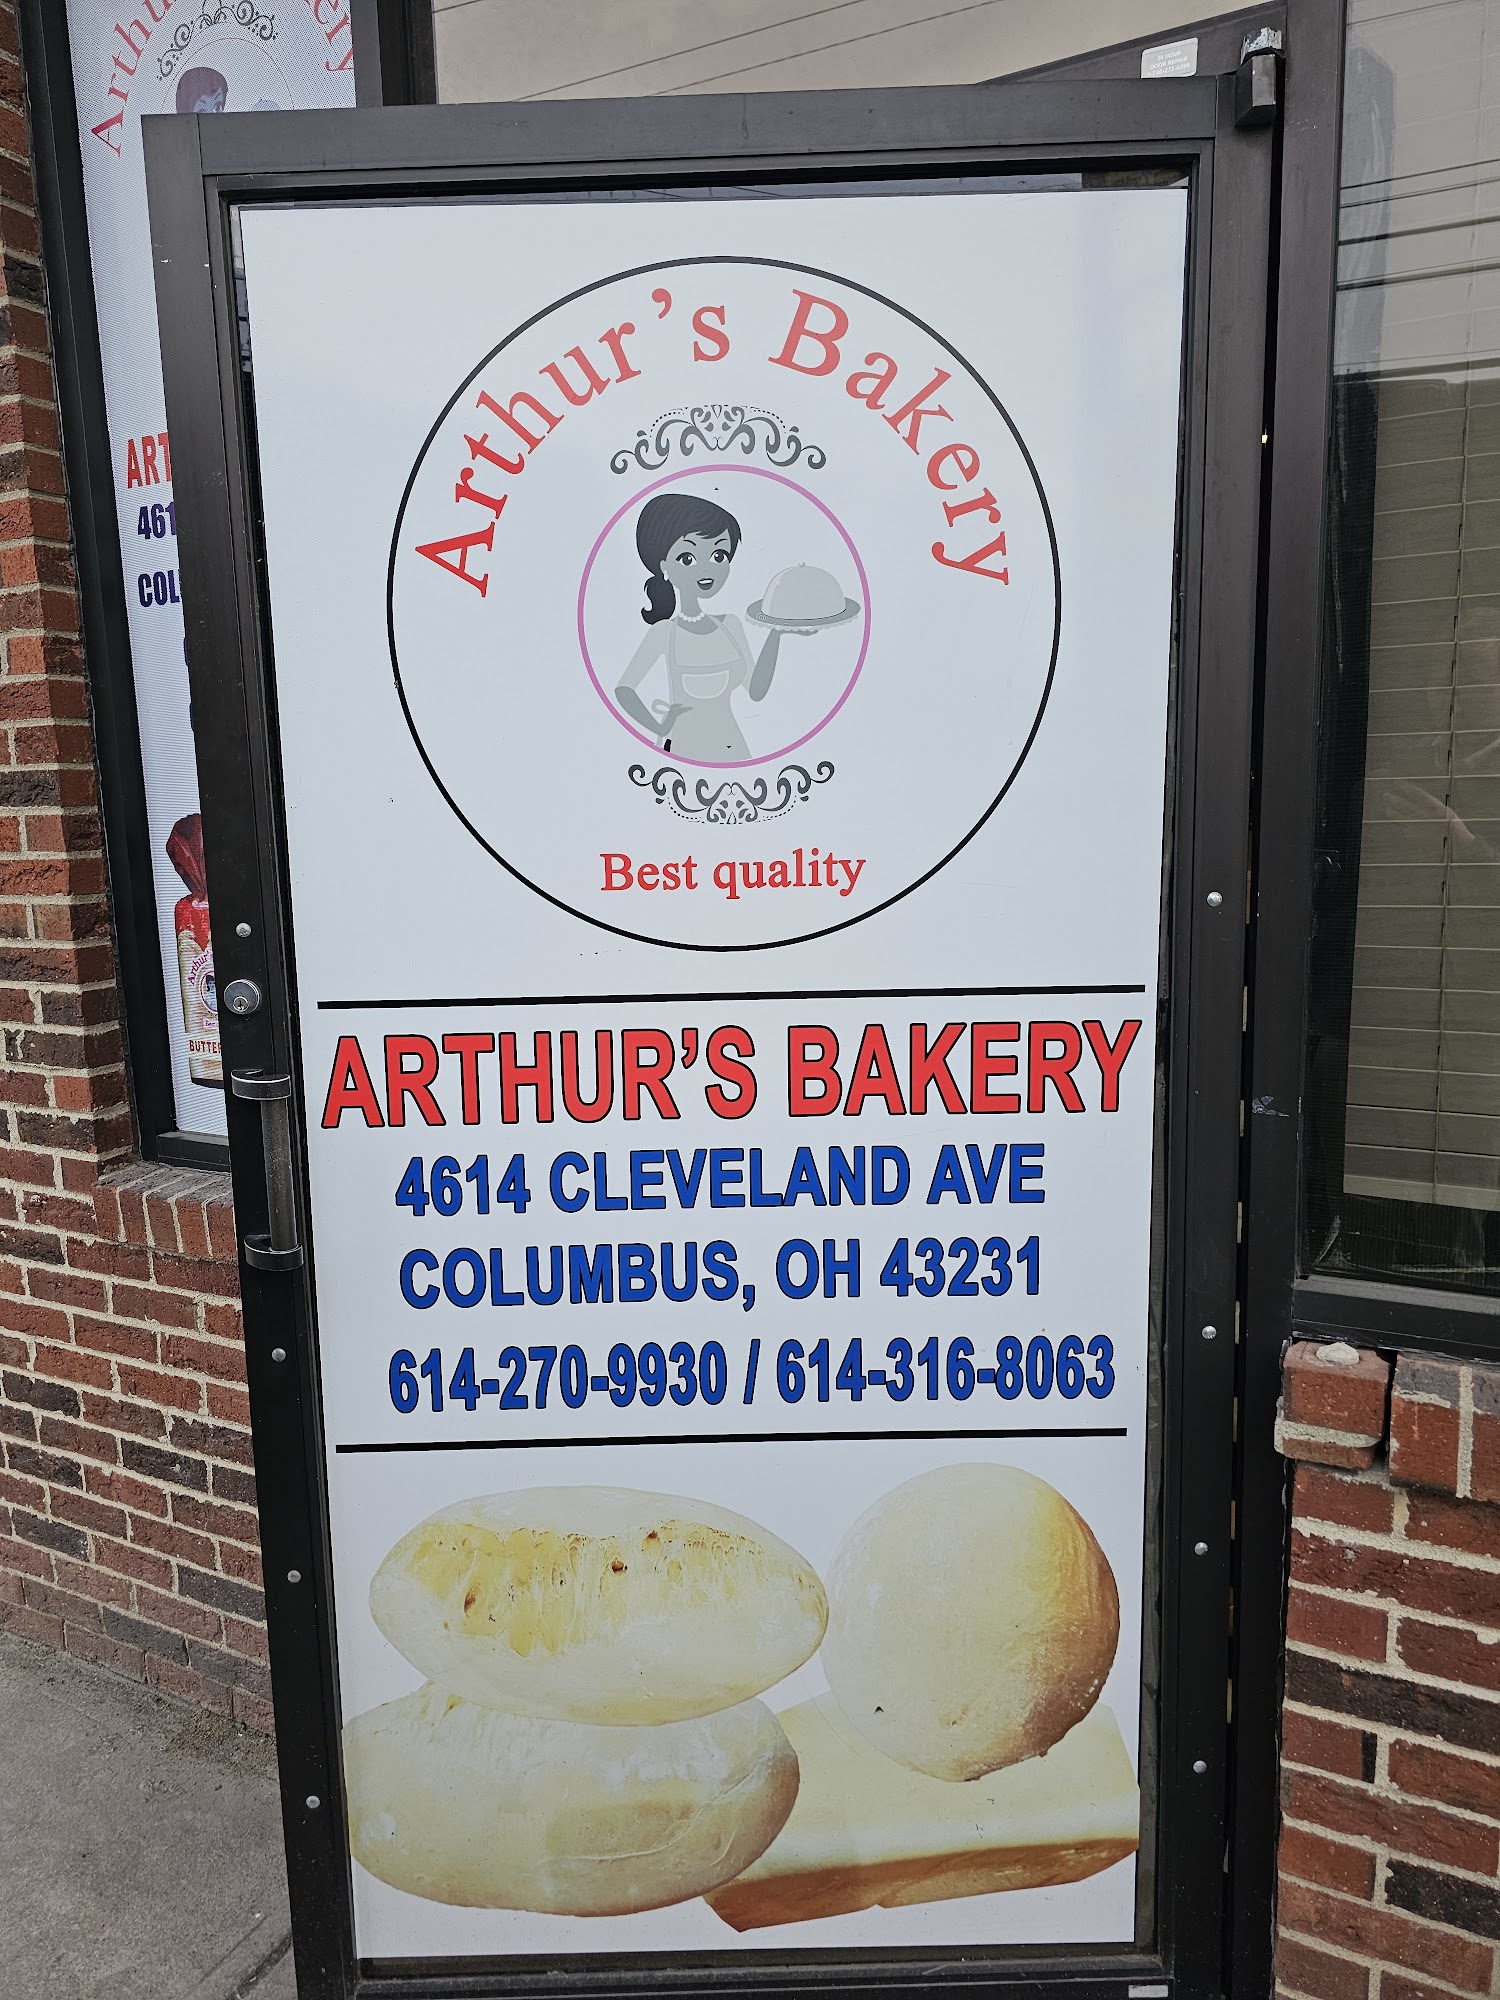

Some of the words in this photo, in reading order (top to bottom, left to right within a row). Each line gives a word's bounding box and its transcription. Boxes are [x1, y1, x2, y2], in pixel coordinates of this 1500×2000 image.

[1150, 61, 1167, 70] DOOR
[1168, 56, 1188, 66] REPAIR
[1164, 51, 1182, 59] HOUR
[415, 288, 730, 598] Arthur's
[768, 289, 1009, 586] Bakery
[600, 853, 698, 891] Best
[713, 847, 867, 900] quality
[321, 1025, 758, 1130] ARTHUR'S
[787, 1019, 1143, 1118] BAKERY
[395, 1153, 531, 1217] 4614
[549, 1145, 911, 1213] CLEVELAND
[926, 1142, 1046, 1205] AVE
[399, 1240, 758, 1312] COLUMBUS,
[775, 1238, 861, 1300] OH
[880, 1235, 1041, 1298] 43231
[388, 1340, 728, 1414] 614-270-9930
[776, 1334, 1116, 1404] 614-316-8063
